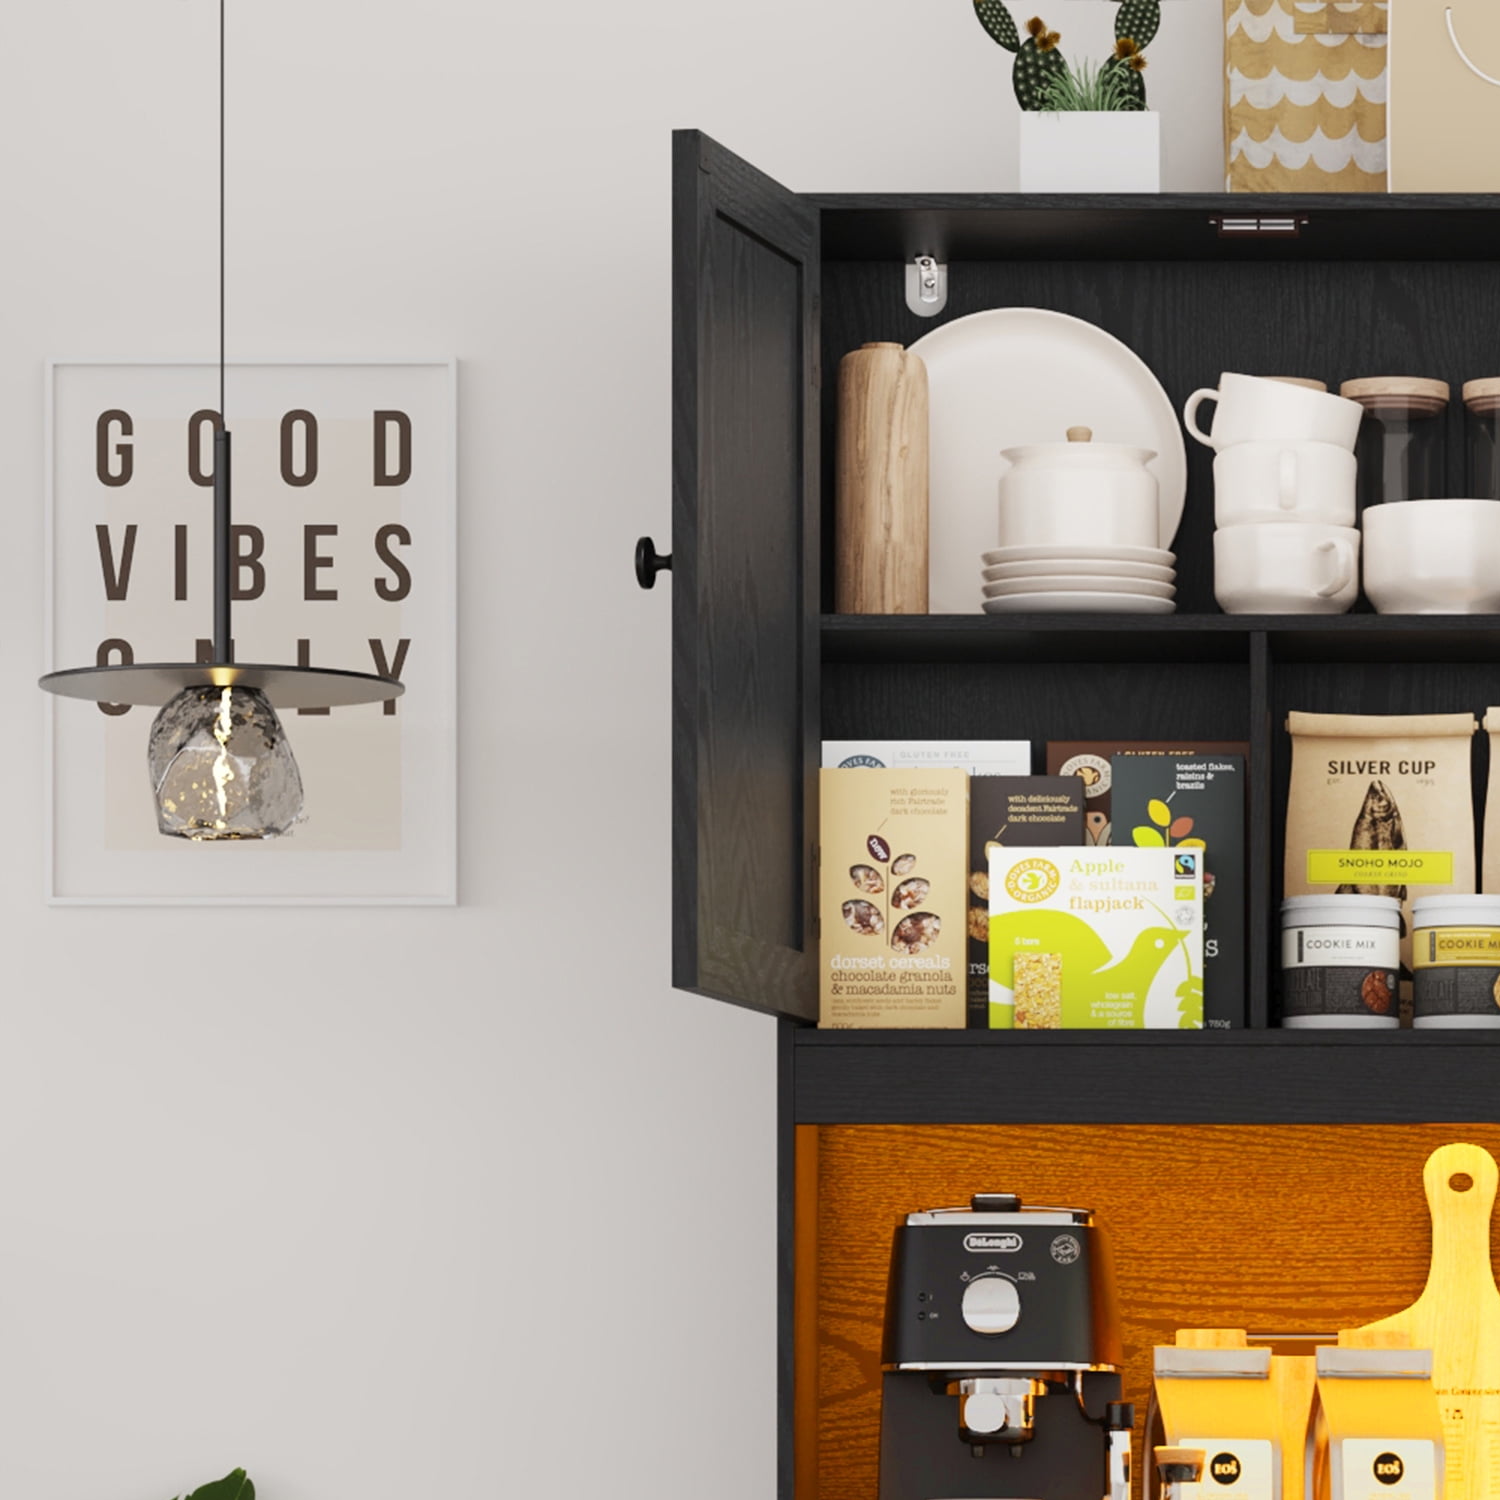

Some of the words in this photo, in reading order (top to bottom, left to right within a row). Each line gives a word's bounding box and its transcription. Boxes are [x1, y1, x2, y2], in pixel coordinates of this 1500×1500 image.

[96, 409, 412, 487] GOOD
[95, 524, 412, 602] VIBES
[1328, 760, 1391, 775] SILVER
[1398, 760, 1436, 775] CUP
[1007, 794, 1027, 803] with
[1007, 815, 1027, 823] dark
[1069, 859, 1125, 876] Apple
[1388, 858, 1424, 868] MOJO
[1013, 880, 1058, 902] ORGANIC
[1069, 879, 1083, 892] &
[1089, 878, 1159, 892] sultana
[1069, 896, 1145, 912] flapjack
[1306, 940, 1353, 949] COOKIE
[1355, 940, 1376, 949] MIX
[1438, 940, 1484, 949] COOKIE
[830, 954, 886, 970] dorset
[889, 954, 951, 970] cereals
[831, 970, 897, 982] chocolate
[899, 970, 953, 985] granola
[831, 985, 843, 995] &
[846, 984, 924, 995] macadamia
[926, 984, 957, 995] nuts
